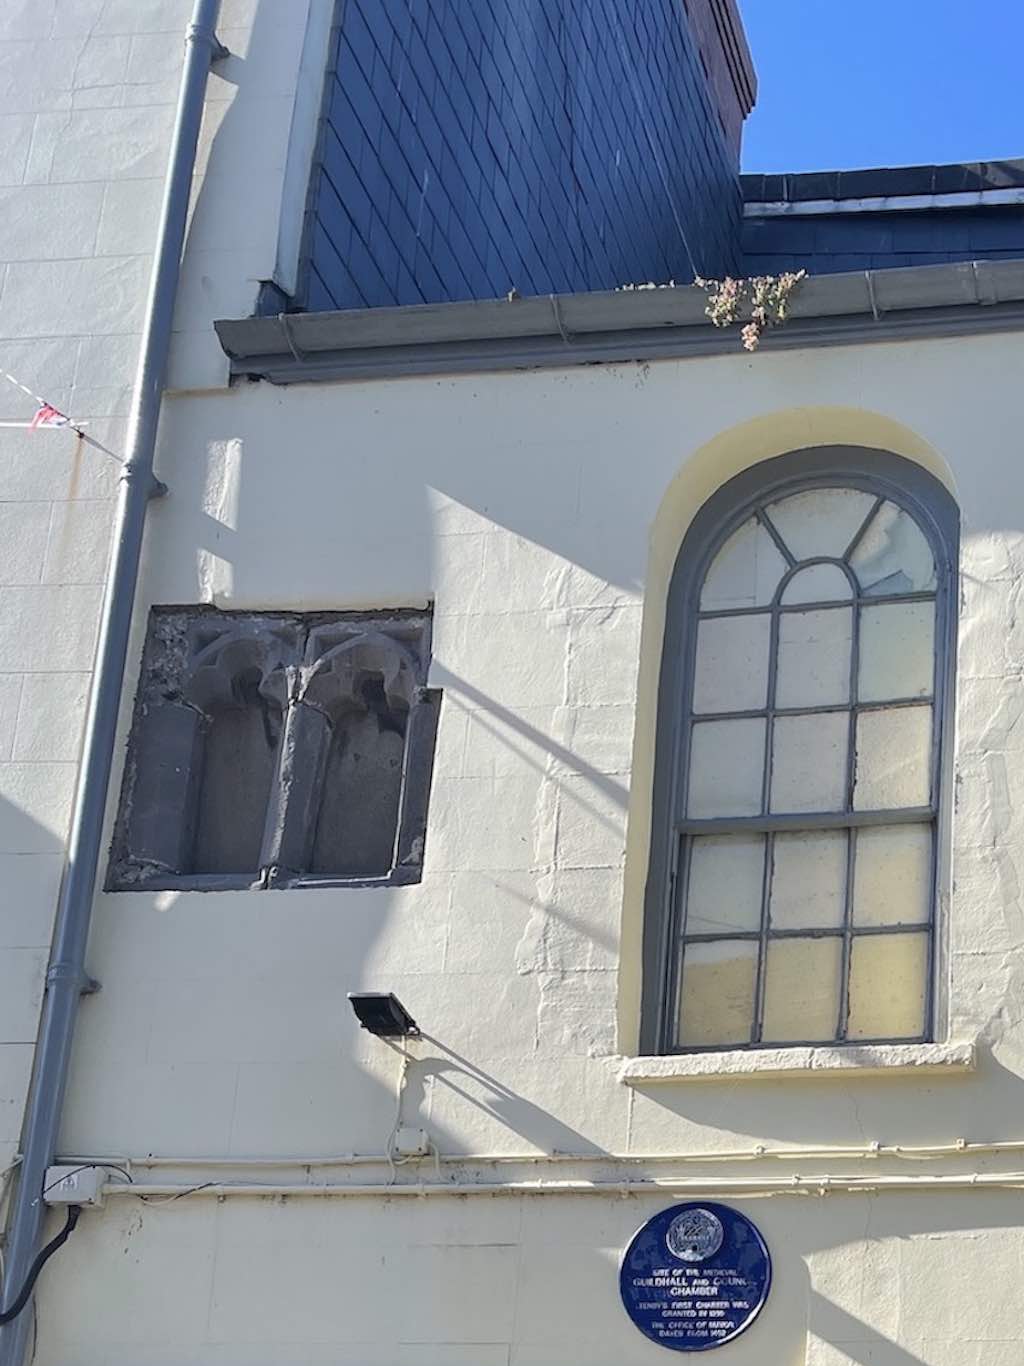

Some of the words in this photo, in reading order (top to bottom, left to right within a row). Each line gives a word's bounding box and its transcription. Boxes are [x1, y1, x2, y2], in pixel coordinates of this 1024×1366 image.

[633, 1277, 688, 1287] GUILDHALL
[670, 1287, 718, 1296] CHAMBER
[662, 1310, 697, 1318] GRANTED
